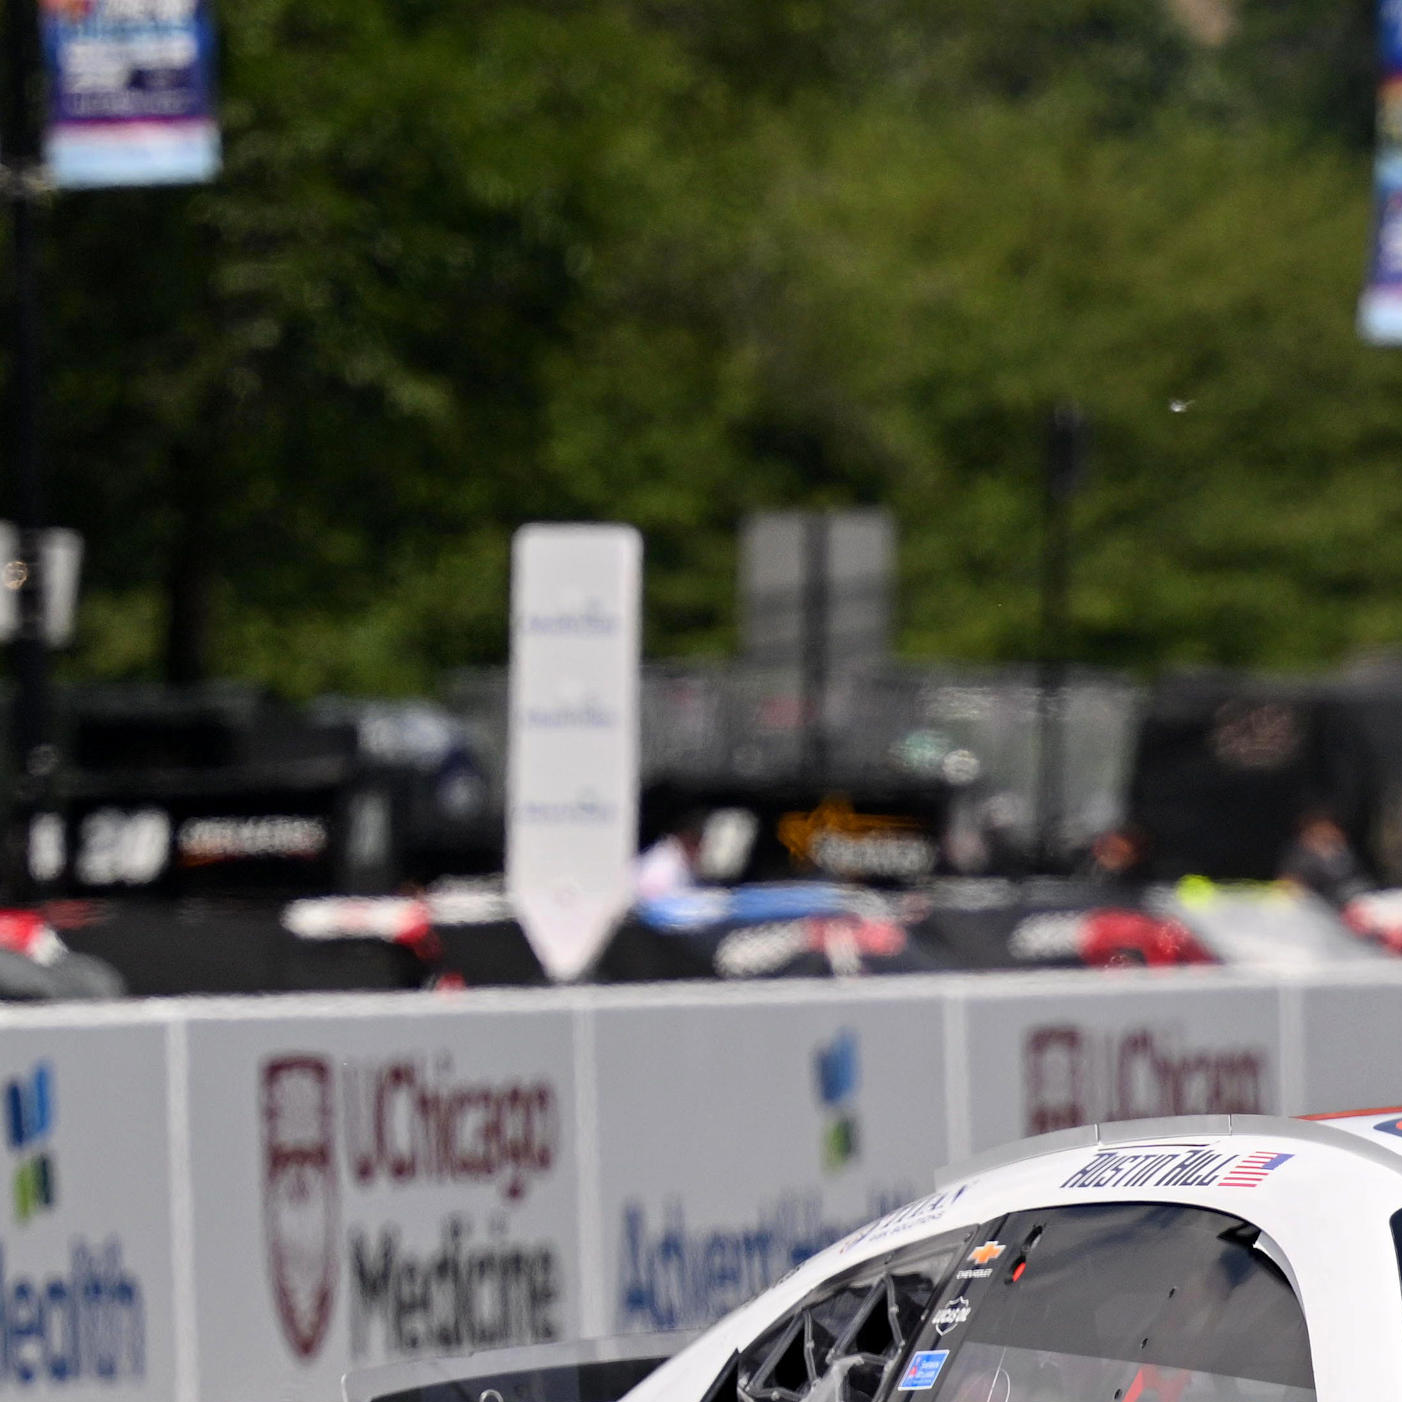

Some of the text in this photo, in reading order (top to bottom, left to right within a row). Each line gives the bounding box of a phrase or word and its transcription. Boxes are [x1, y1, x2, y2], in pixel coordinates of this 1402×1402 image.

[344, 1052, 557, 1200] UChicago
[1060, 1150, 1240, 1189] AUSTIN HILL
[0, 1230, 148, 1386] ealth
[349, 1213, 560, 1362] Medicine
